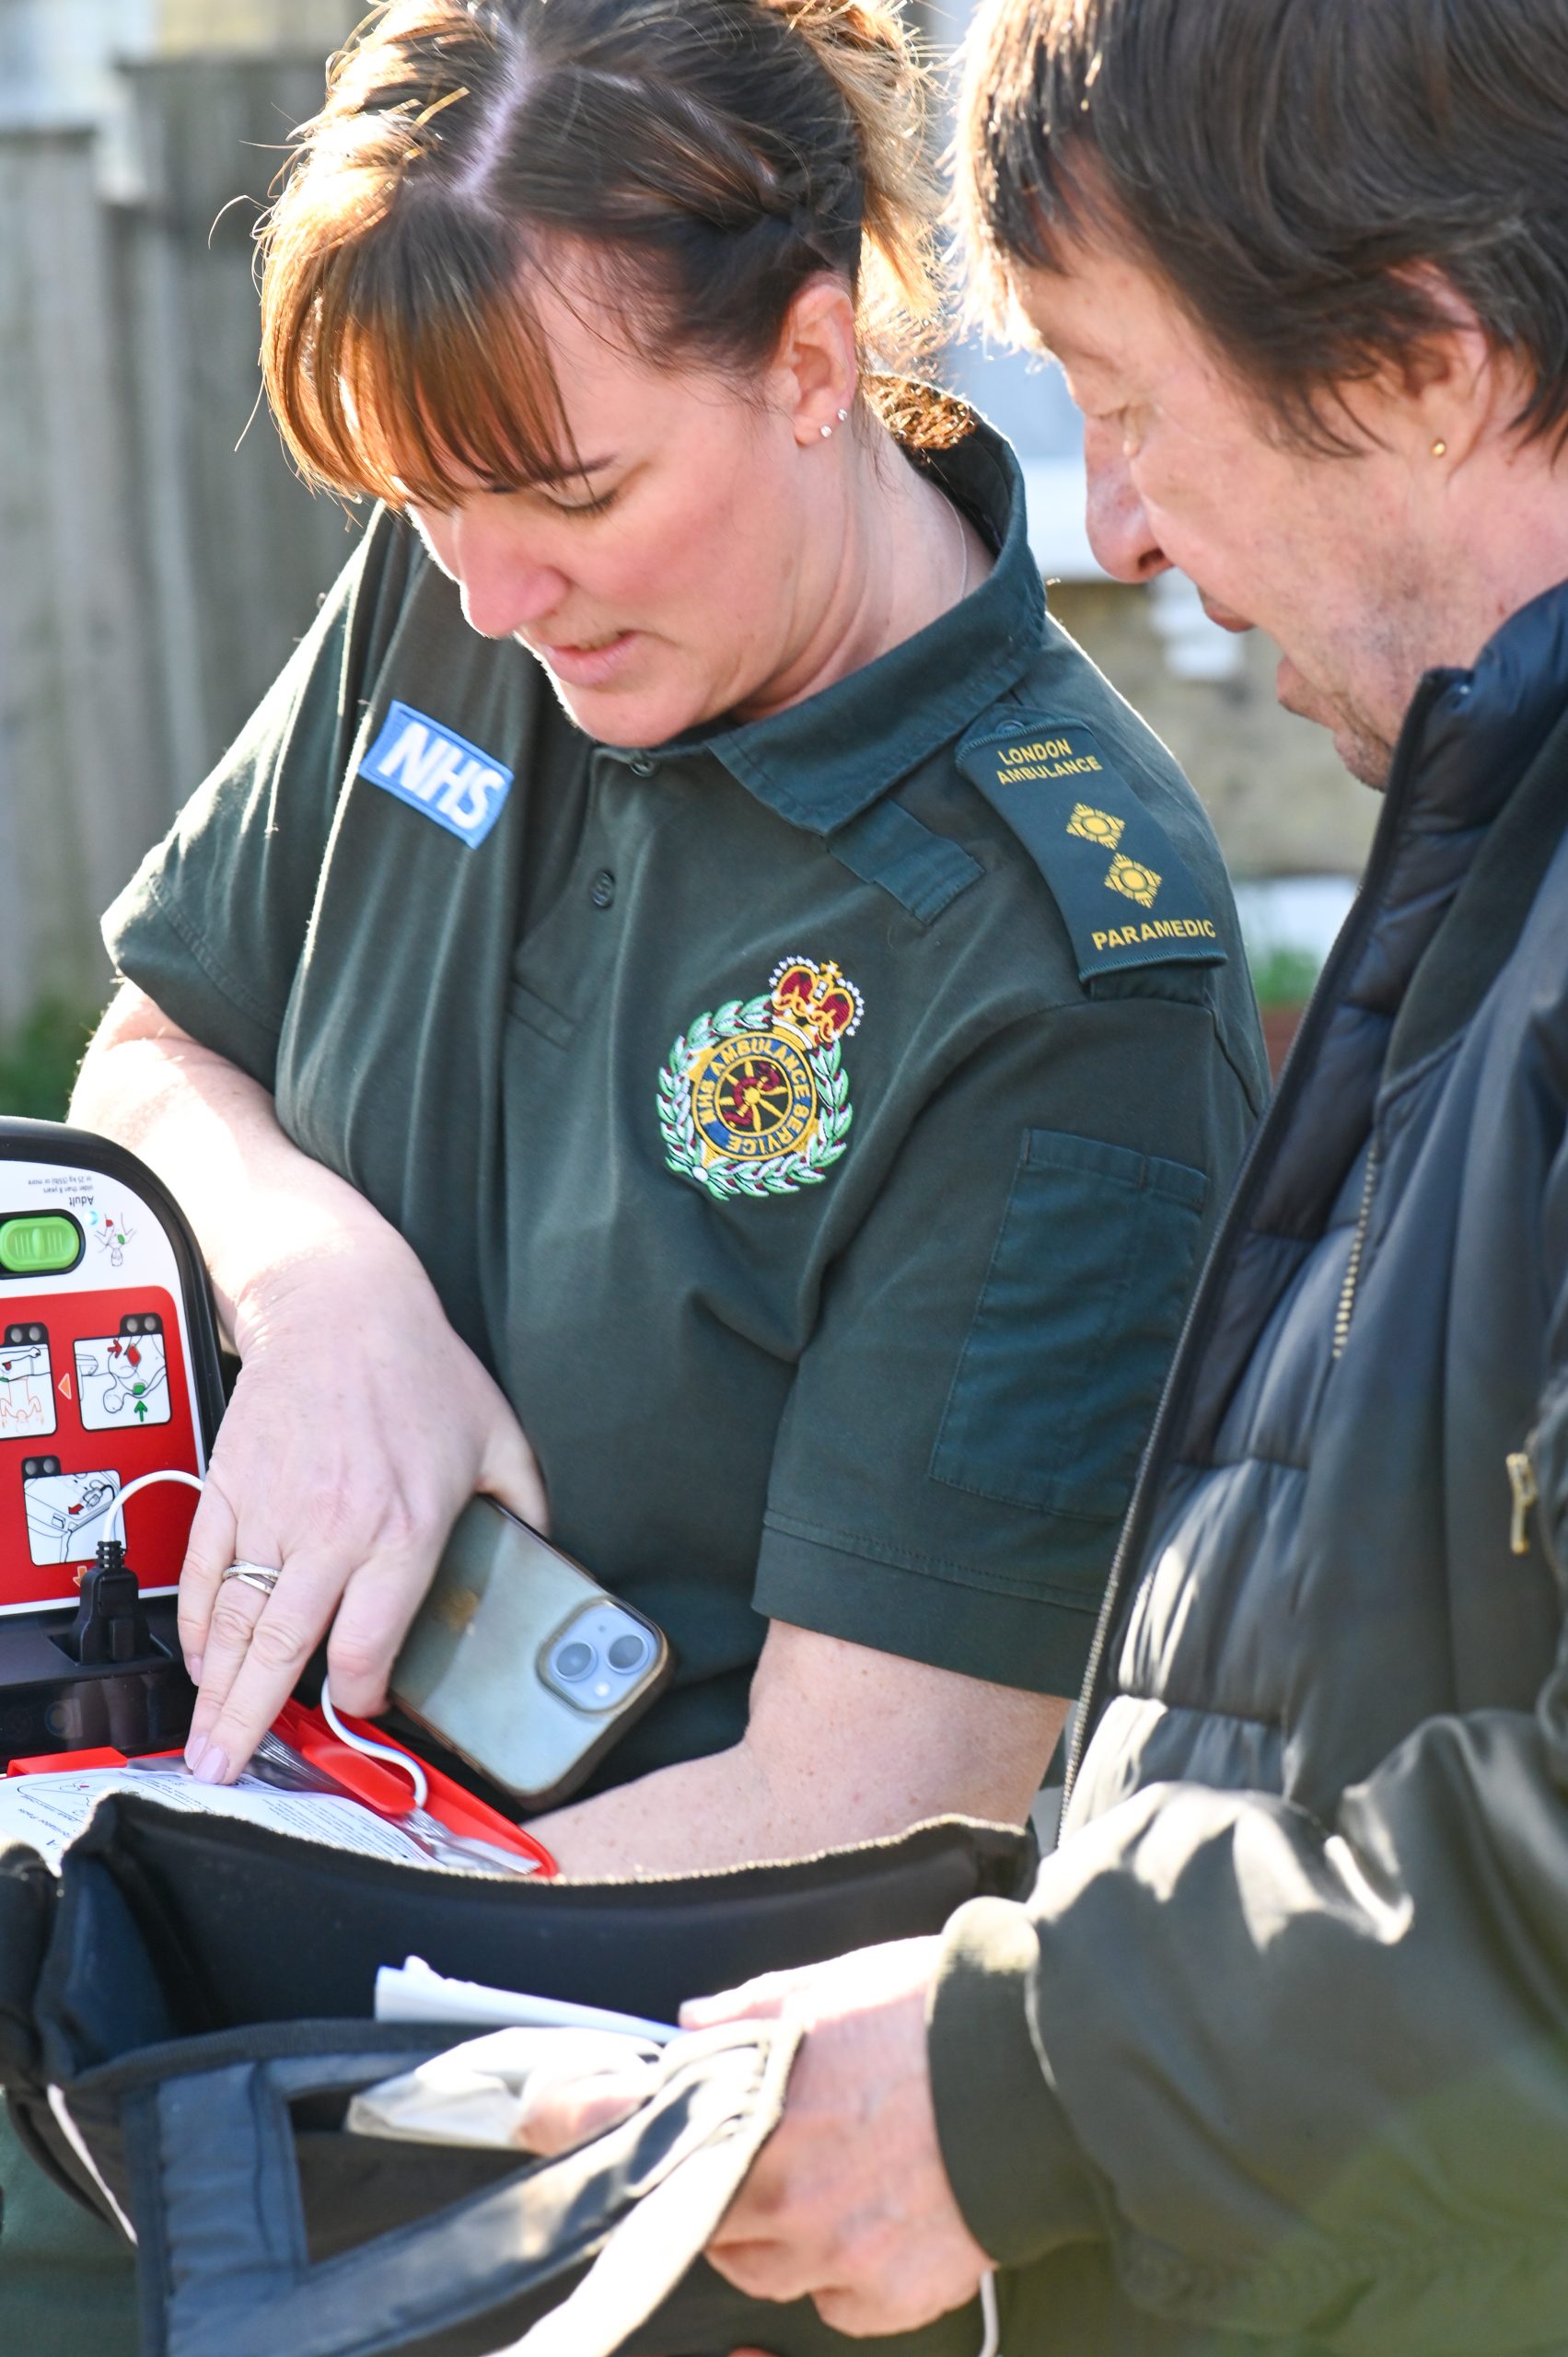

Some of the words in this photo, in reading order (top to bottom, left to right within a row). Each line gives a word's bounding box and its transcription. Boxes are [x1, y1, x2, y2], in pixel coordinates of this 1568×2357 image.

[997, 737, 1073, 765] LONDON
[377, 721, 505, 830] NHS
[995, 755, 1103, 785] AMBULANCE
[1091, 918, 1217, 951] PARAMEDIC
[711, 1038, 811, 1099] AMBULANCE
[727, 1105, 810, 1155] SERVICE
[69, 1196, 94, 1207] Adult
